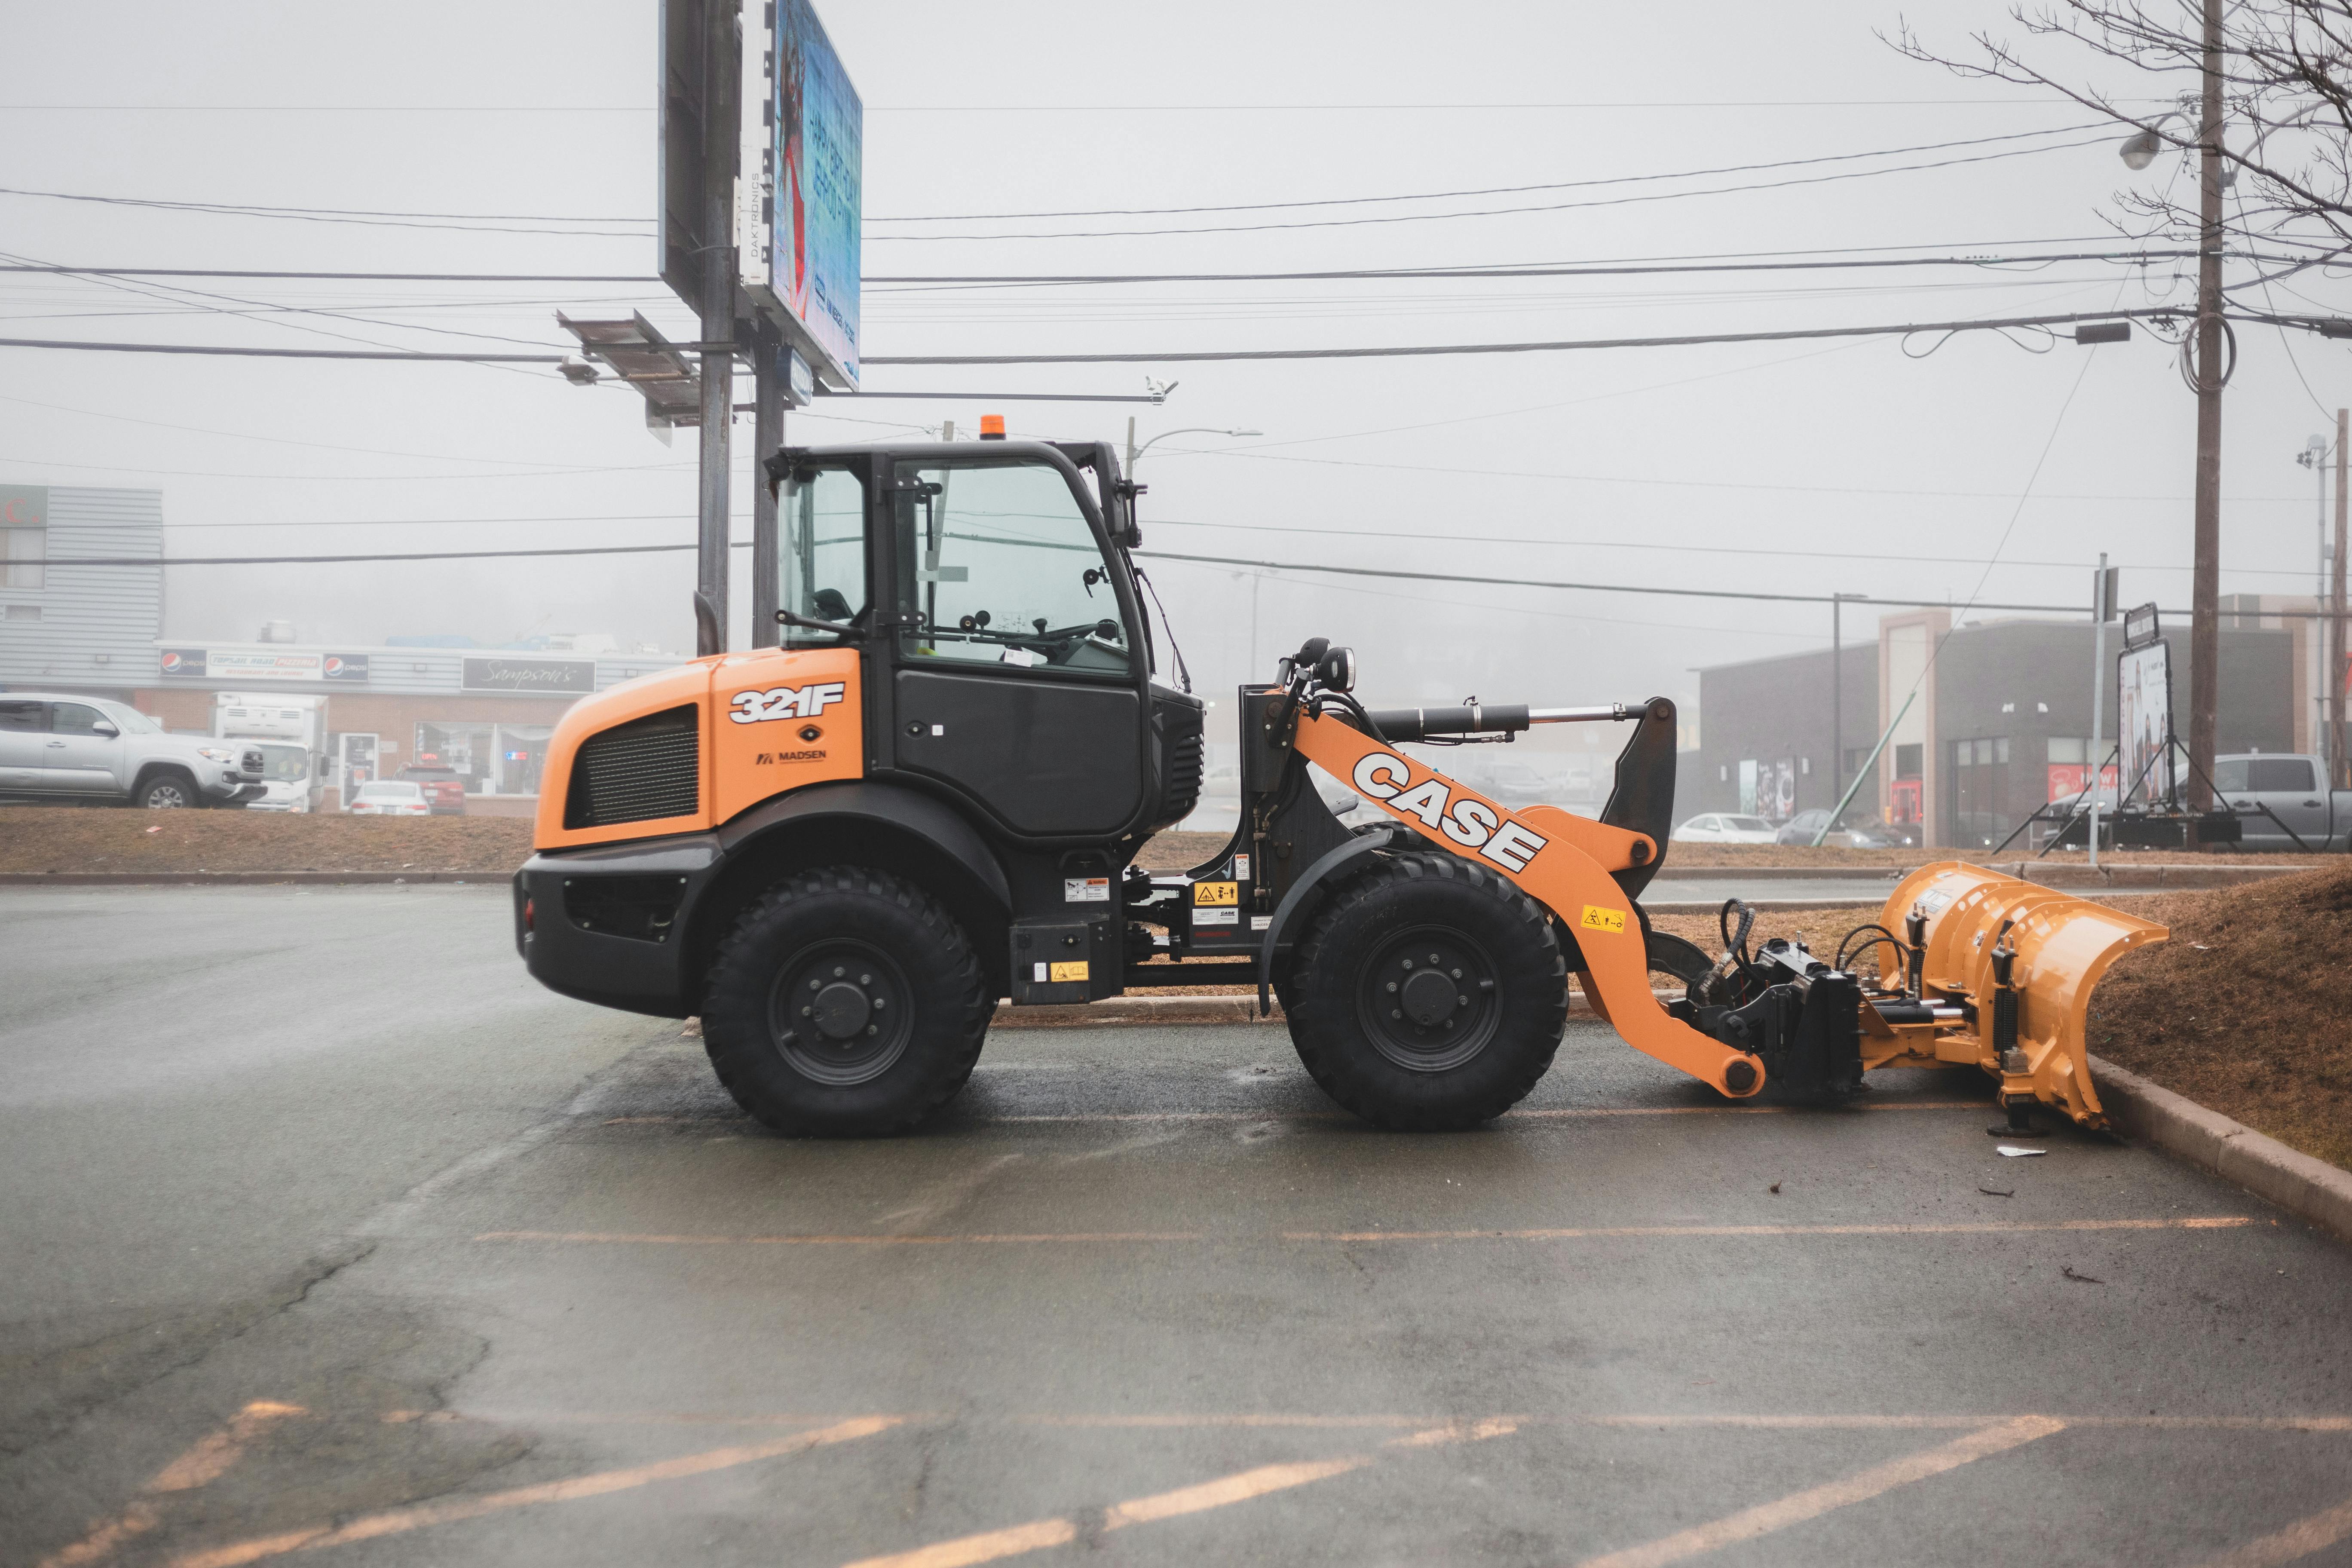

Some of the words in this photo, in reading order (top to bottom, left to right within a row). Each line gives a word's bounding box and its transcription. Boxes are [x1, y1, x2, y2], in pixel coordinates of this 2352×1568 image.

[751, 173, 759, 257] DAKTRONICS
[482, 659, 576, 689] Sampson's
[728, 681, 845, 724] 321F
[779, 750, 826, 760] MADSEN
[1352, 752, 1550, 874] CASE
